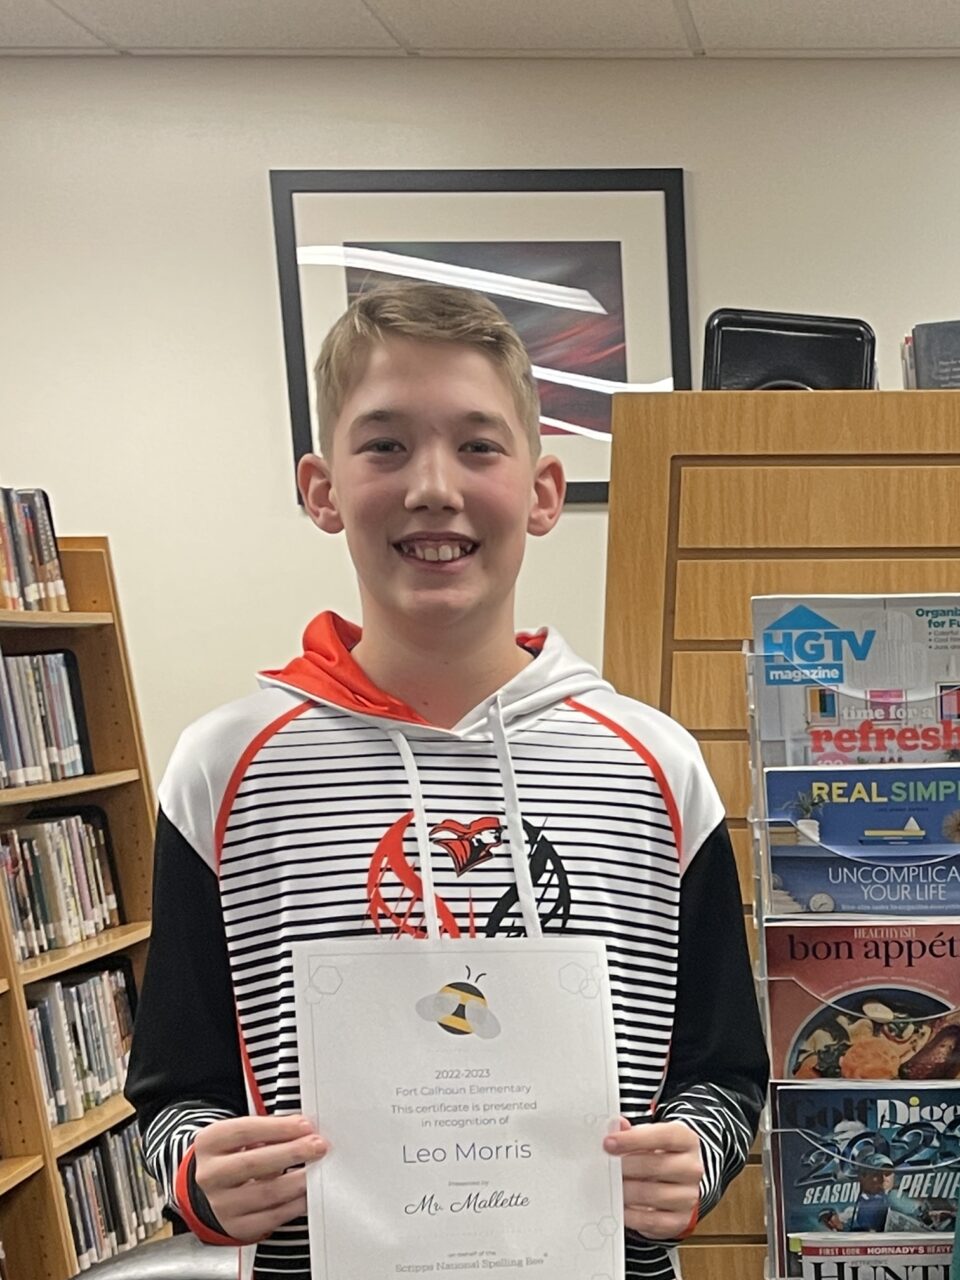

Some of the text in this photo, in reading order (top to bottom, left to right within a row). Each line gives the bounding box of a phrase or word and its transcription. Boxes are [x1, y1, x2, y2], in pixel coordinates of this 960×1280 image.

[928, 619, 946, 629] for
[763, 630, 876, 663] HGTV
[770, 666, 839, 681] magazine
[842, 704, 934, 720] time for a
[812, 781, 889, 803] REAL
[861, 884, 947, 901] YOUR LIFE
[788, 933, 854, 961] bon
[435, 1068, 491, 1080] 2022-2023
[395, 1084, 532, 1097] Fort Calhoun Elementary
[391, 1100, 538, 1114] This certificate is presented
[421, 1115, 510, 1128] in recognition of
[402, 1139, 532, 1164] Leo Morris
[803, 1182, 861, 1205] SEASON
[404, 1190, 530, 1216] Mr. Mallette
[867, 1245, 925, 1255] HORNADY'S
[395, 1264, 434, 1274] Scripps
[436, 1261, 480, 1271] National
[482, 1258, 524, 1269] Spelling
